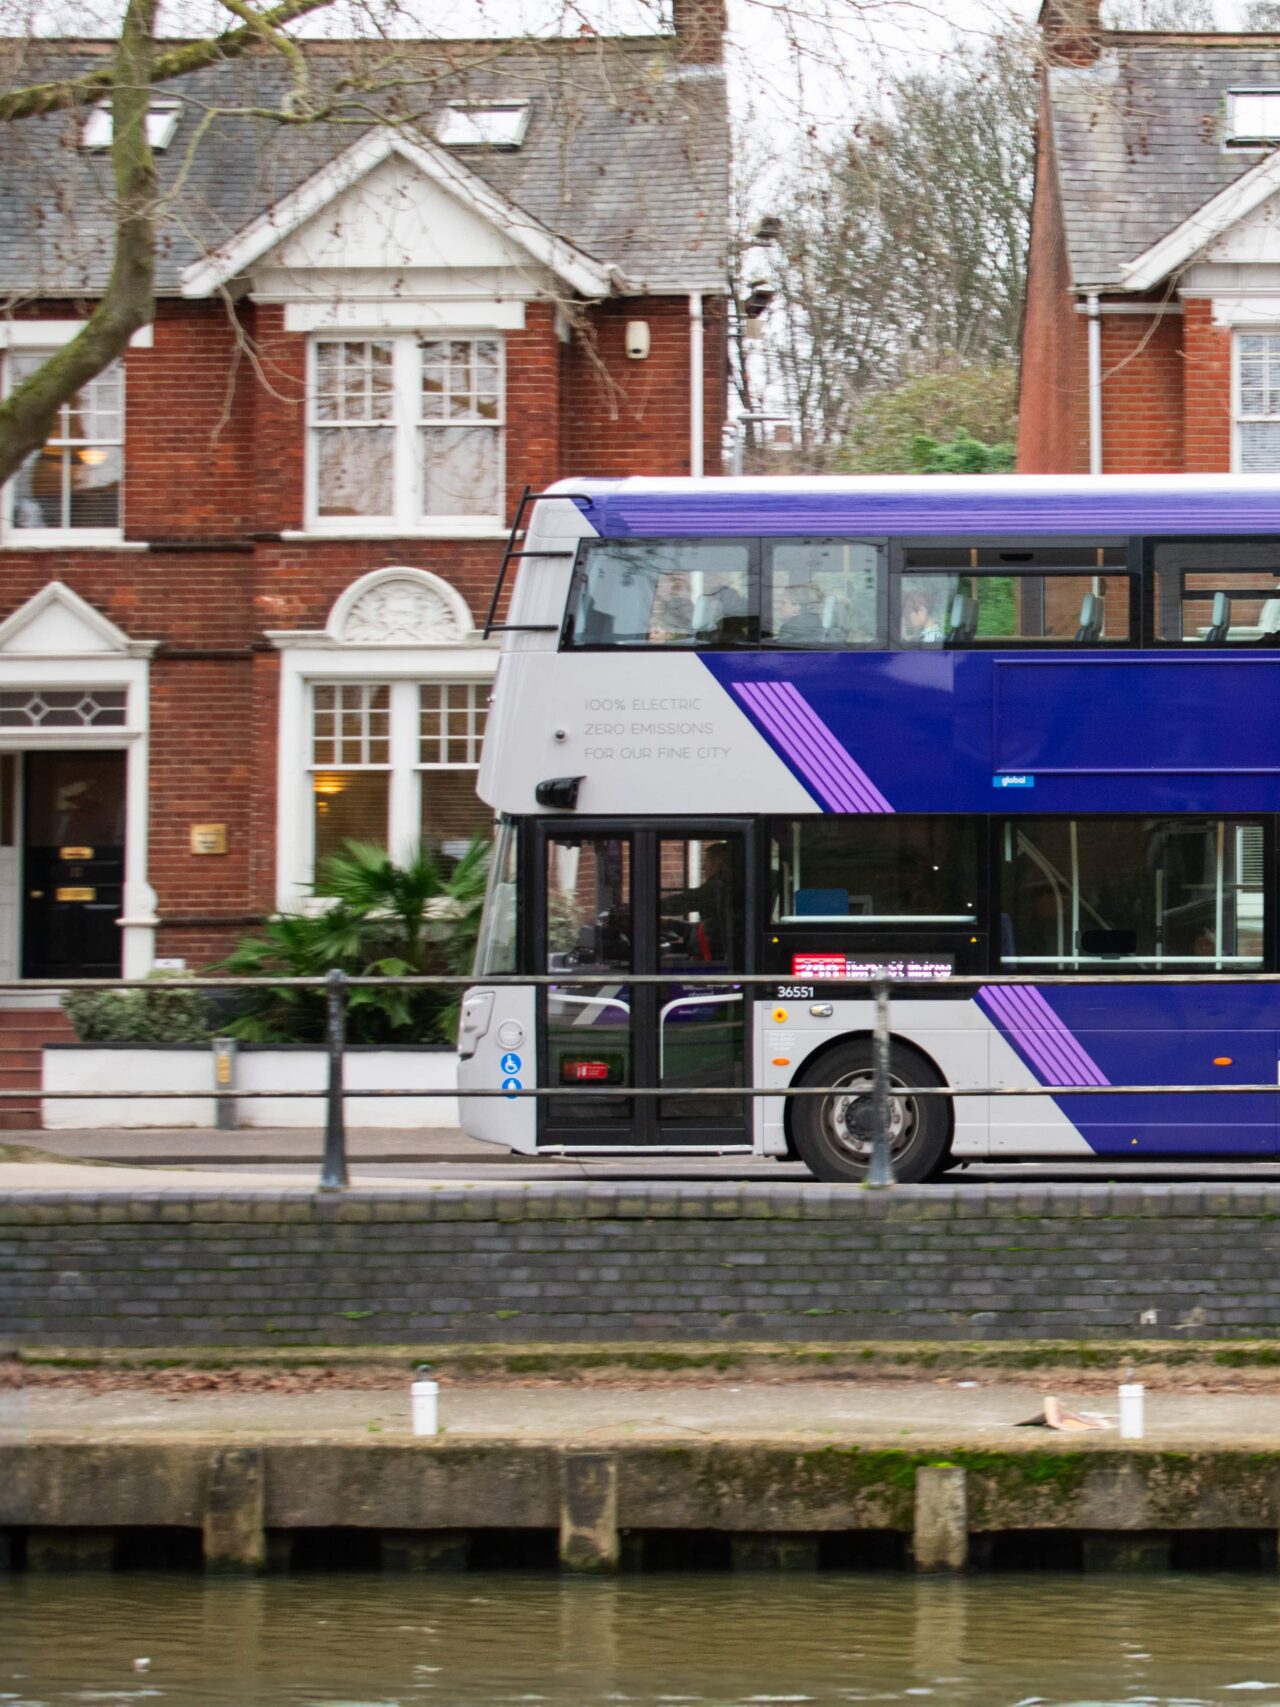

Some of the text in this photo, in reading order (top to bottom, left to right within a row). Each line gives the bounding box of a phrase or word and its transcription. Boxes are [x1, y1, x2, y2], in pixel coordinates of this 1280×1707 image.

[632, 698, 702, 711] ELECTRIC
[584, 722, 714, 736] ZERO EMISSIONS
[584, 747, 731, 759] FOR OUR FINE CITY
[1001, 775, 1026, 787] global
[777, 986, 815, 998] 36551
